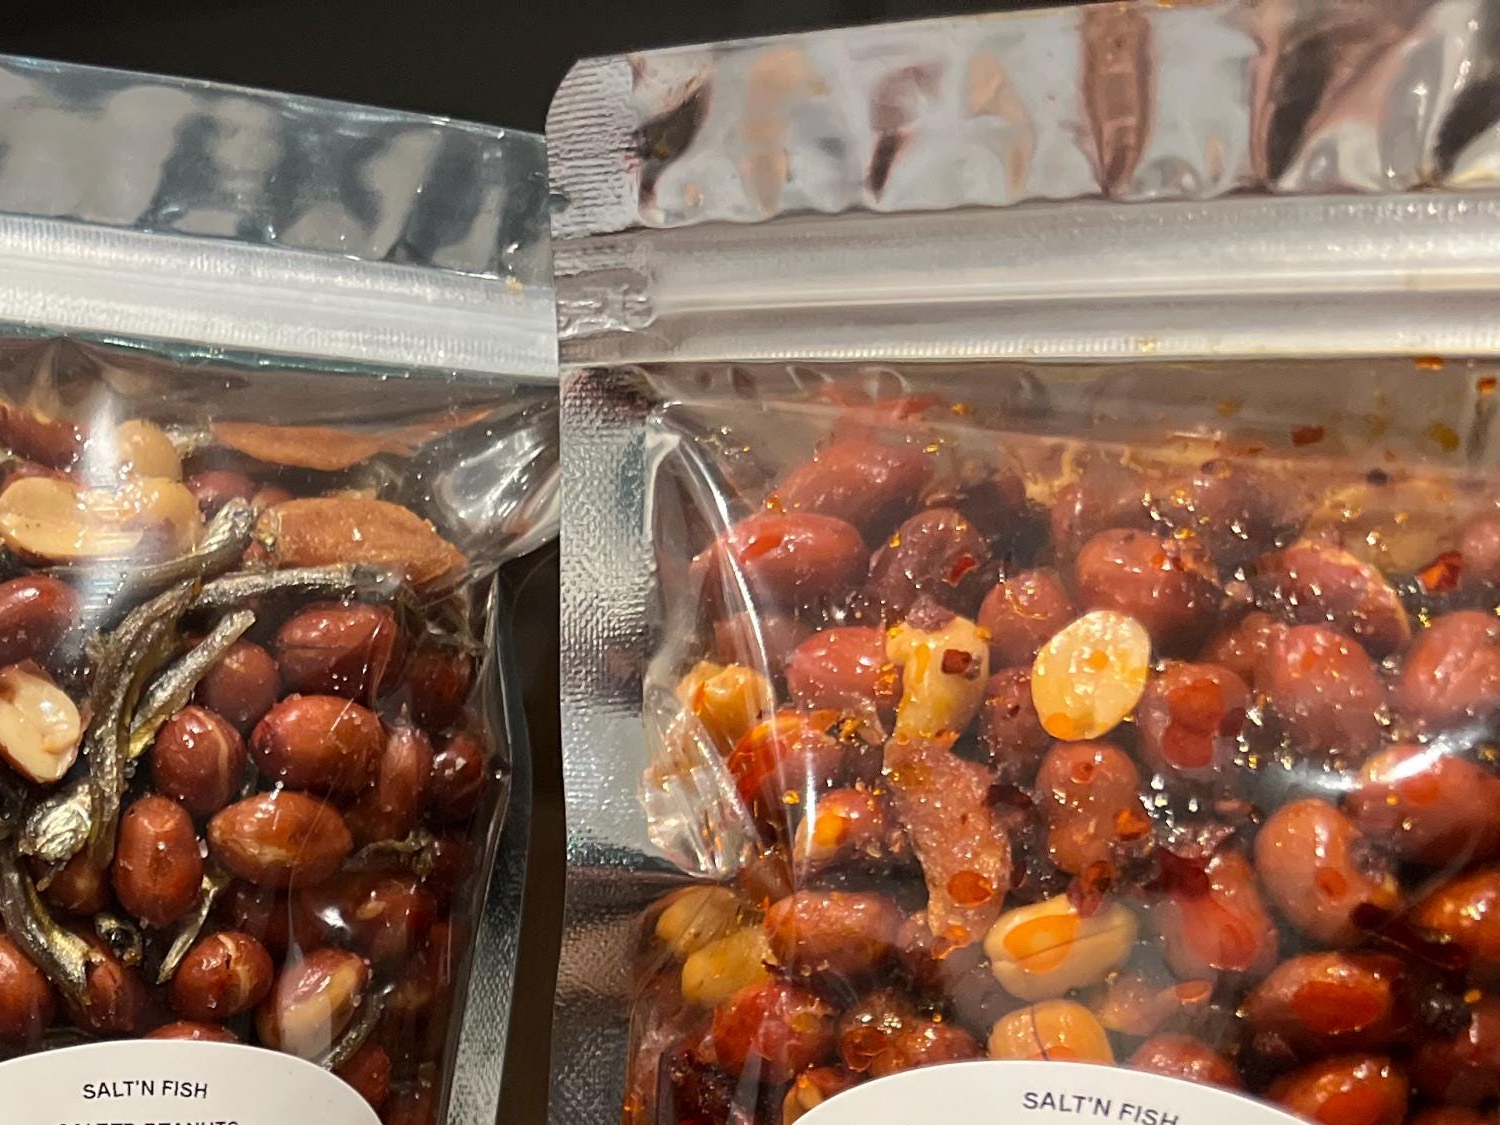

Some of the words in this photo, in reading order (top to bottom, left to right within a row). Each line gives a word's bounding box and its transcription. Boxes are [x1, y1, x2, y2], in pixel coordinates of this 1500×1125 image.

[83, 1080, 154, 1099] SALT'N
[162, 1080, 208, 1099] FISH
[1023, 1092, 1112, 1117] SALT'N
